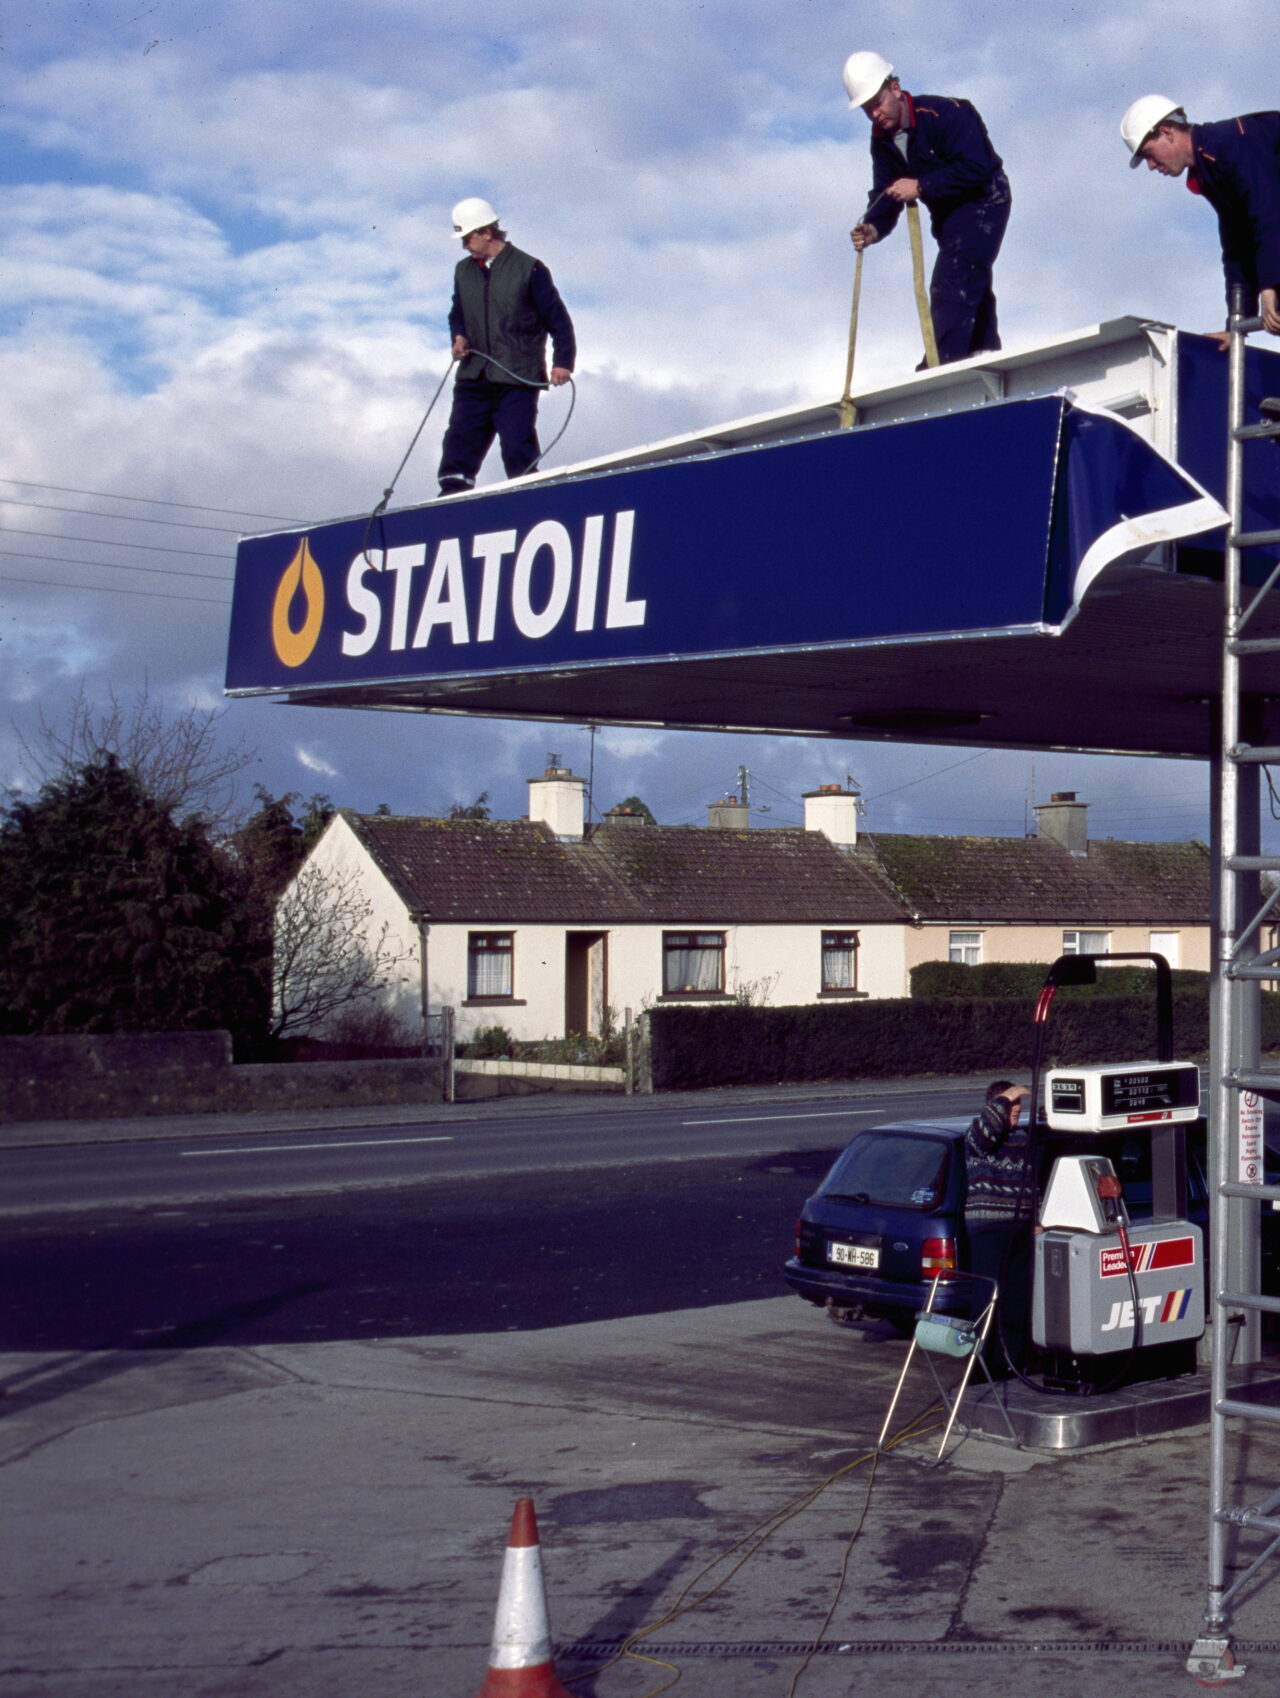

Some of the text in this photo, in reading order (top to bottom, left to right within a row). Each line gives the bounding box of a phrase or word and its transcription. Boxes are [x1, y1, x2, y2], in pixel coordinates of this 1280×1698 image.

[341, 509, 647, 657] STATOIL
[1102, 1249, 1135, 1262] Premi
[1101, 1295, 1162, 1331] JET
